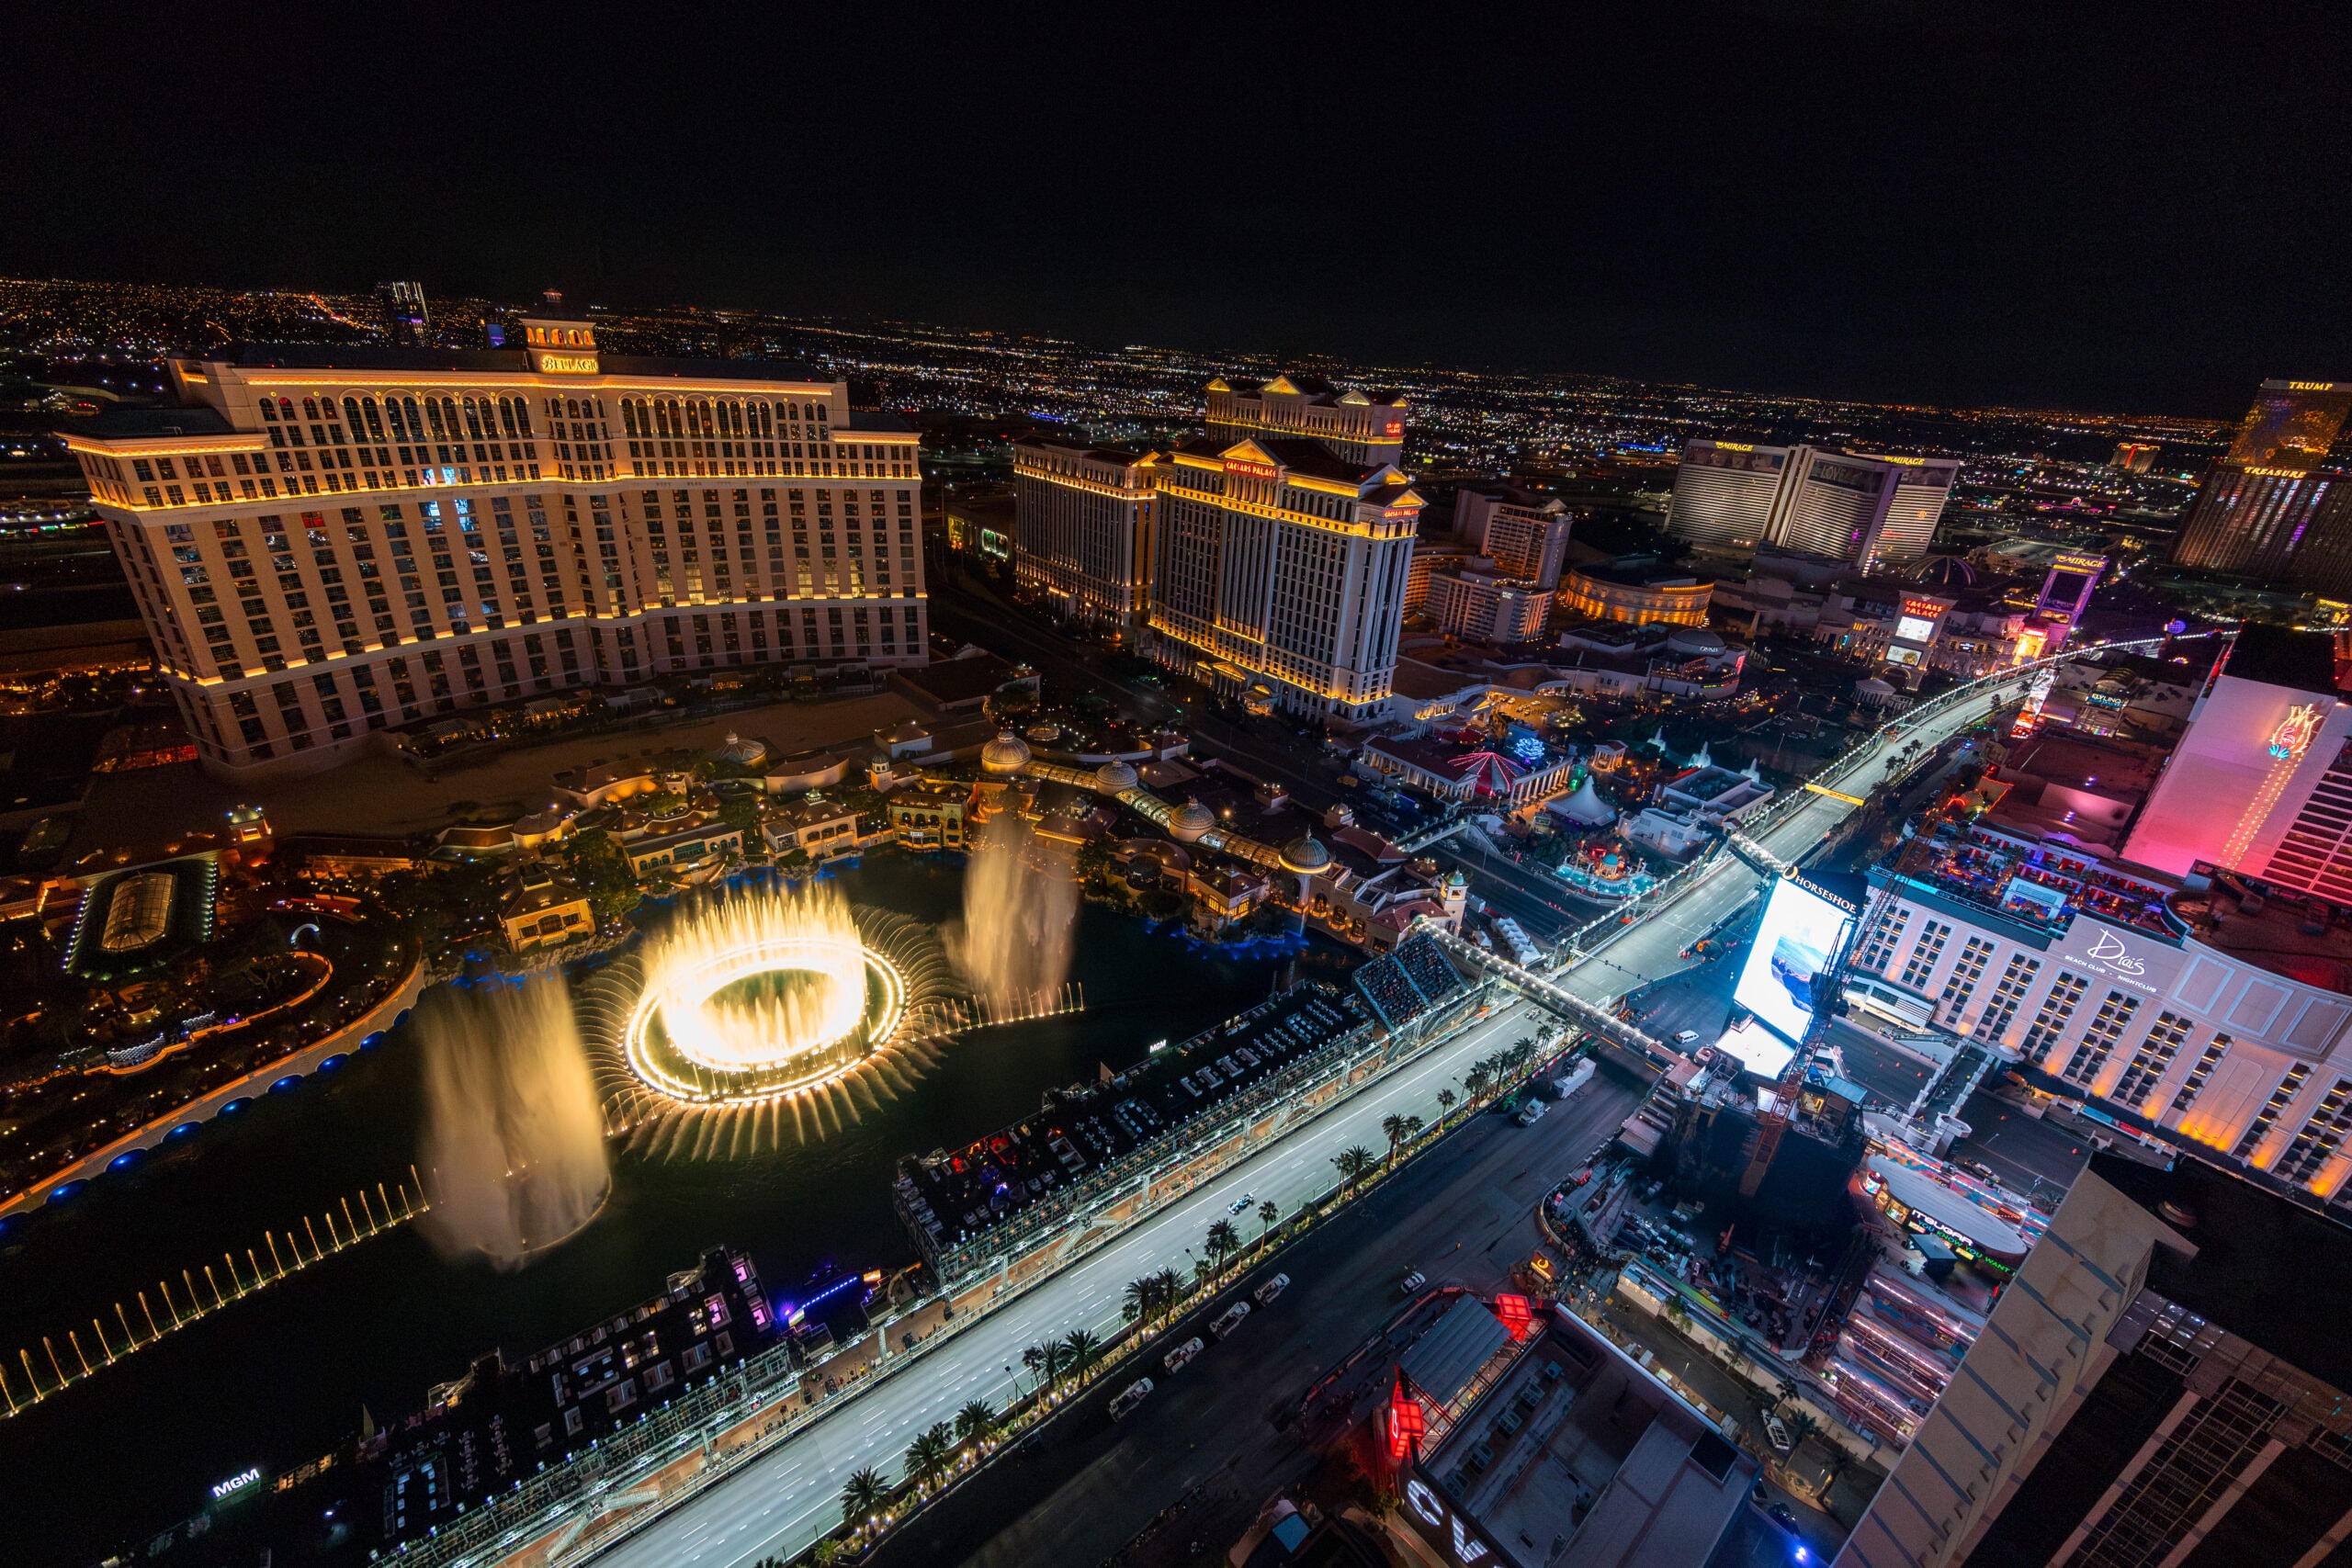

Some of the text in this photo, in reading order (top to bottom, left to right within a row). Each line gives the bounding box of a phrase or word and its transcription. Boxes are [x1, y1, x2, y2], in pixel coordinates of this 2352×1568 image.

[2290, 381, 2333, 390] TRUMP
[1724, 442, 1753, 451] MIRAGE
[1226, 461, 1277, 478] CAESARS PALACE
[2244, 466, 2307, 479] TREASURE
[2066, 557, 2105, 569] MIRAGE
[1905, 600, 1943, 613] CAESARS
[1905, 606, 1939, 618] PALACE
[1794, 874, 1857, 914] HORSESHOE
[2064, 954, 2157, 993] BEACH CLUB NIGHTCLUB
[1149, 1039, 1167, 1054] MGM
[1917, 1219, 1936, 1233] YOU
[1936, 1230, 1963, 1247] KNOW
[1965, 1245, 1984, 1259] YOU
[1984, 1255, 2011, 1273] WANT
[212, 1468, 260, 1497] MGM
